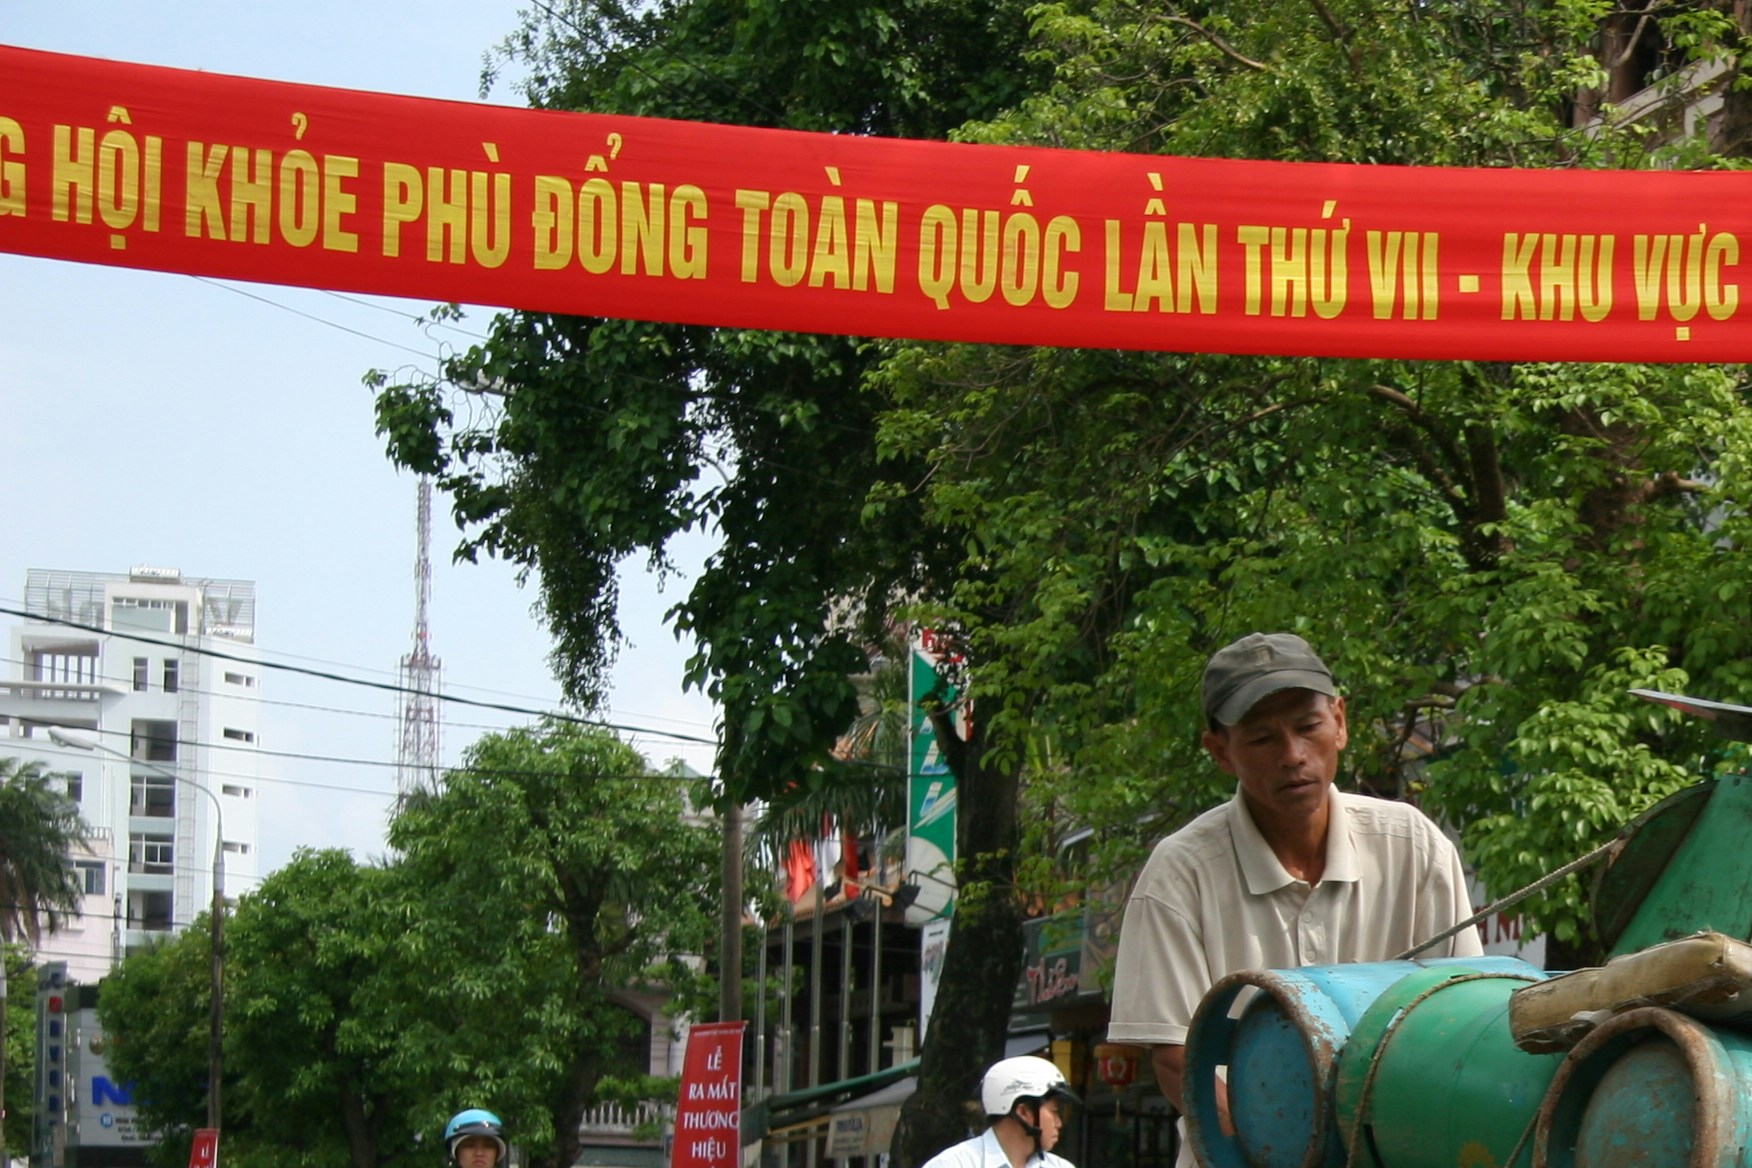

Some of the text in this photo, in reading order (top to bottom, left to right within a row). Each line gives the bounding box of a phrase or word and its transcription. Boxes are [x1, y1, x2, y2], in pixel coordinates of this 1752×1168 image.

[52, 106, 161, 250] HỘI
[185, 112, 359, 253] KHỎE
[382, 142, 511, 269] PHÙ
[532, 132, 707, 280] ĐỔNG
[735, 166, 899, 294] TOÀN
[917, 165, 1080, 310] QUỐC
[1104, 172, 1218, 315] LẦN
[1237, 200, 1351, 320] THỨ
[1366, 231, 1439, 320] VII
[1501, 232, 1615, 322] KHU
[1633, 222, 1740, 341] VỰC
[688, 1083, 704, 1100] RA
[691, 1137, 726, 1163] HIỆU
